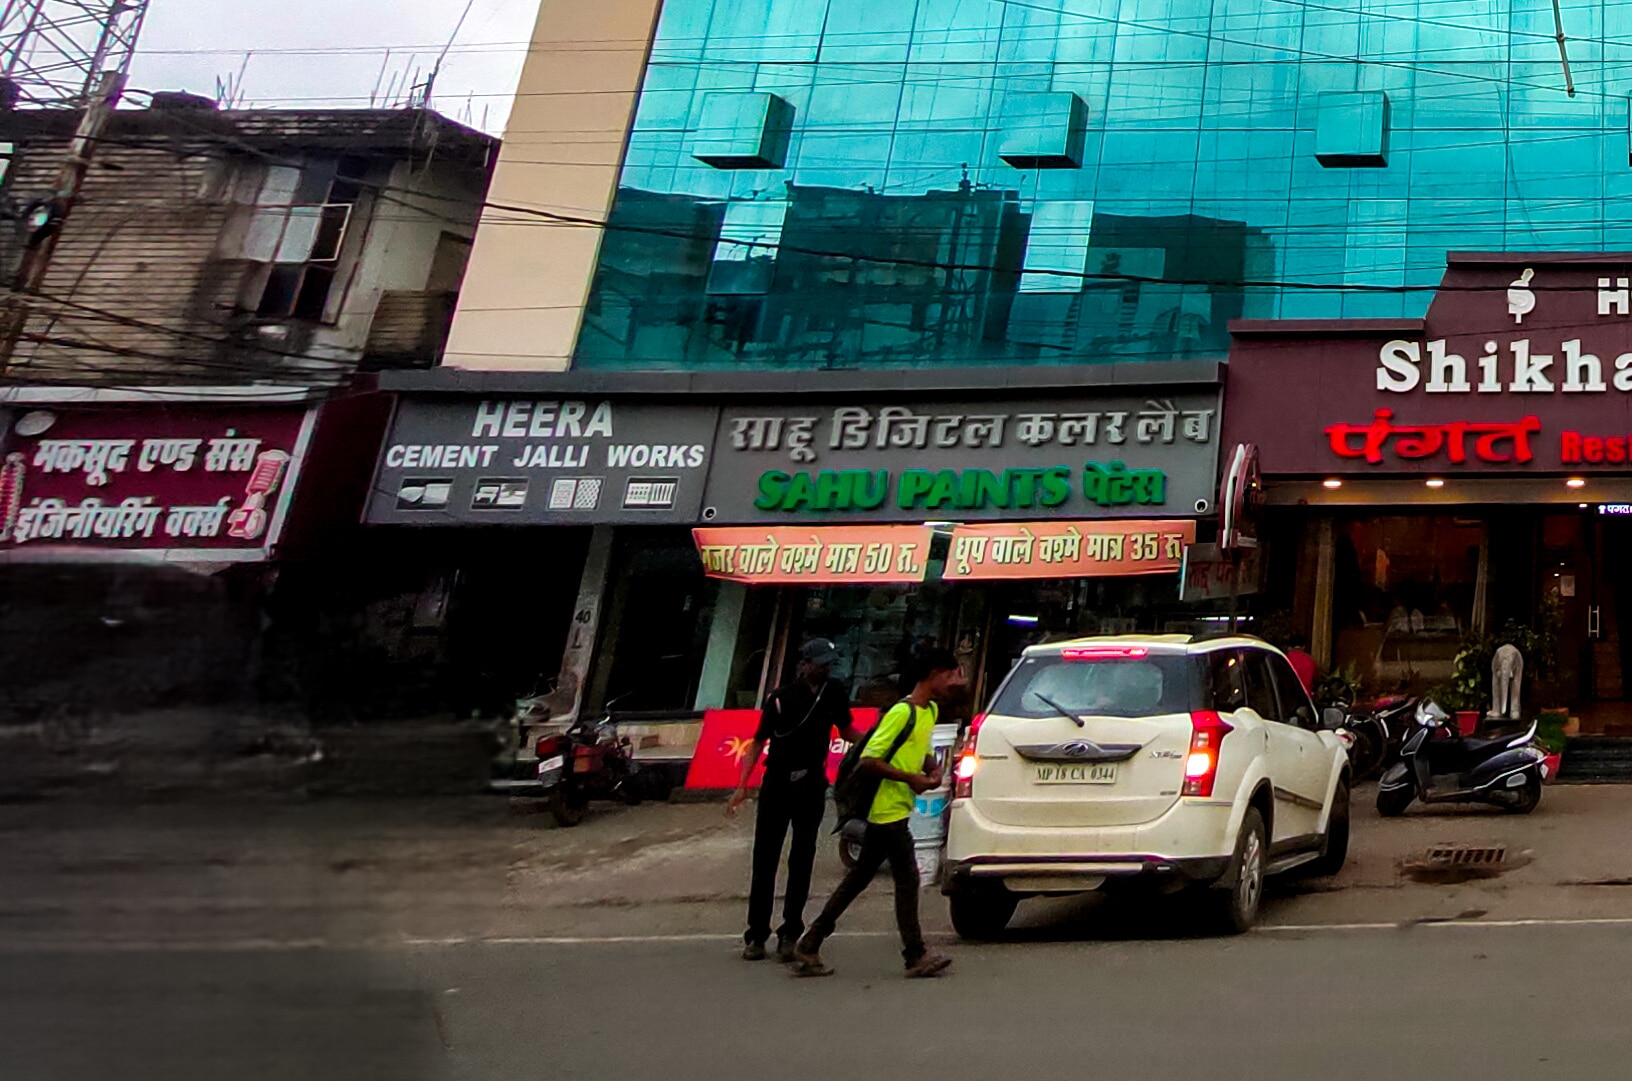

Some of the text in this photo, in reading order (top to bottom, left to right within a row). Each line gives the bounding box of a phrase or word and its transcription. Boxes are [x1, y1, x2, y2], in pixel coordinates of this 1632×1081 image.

[471, 400, 614, 438] HEERA
[730, 416, 822, 462] साहू
[828, 406, 1009, 448] डिजिटल
[1016, 411, 1130, 446] कलर
[33, 428, 261, 486] मकसूद एण्ड संस
[386, 445, 705, 469] CEMENT JALLI WORKS
[753, 465, 1072, 511] SAHU PAINTS
[740, 534, 780, 574] वाले
[825, 544, 863, 574] मात्र
[864, 543, 893, 573] 50
[955, 536, 989, 575] धूप
[991, 527, 1036, 564] वाले
[1087, 533, 1126, 562] मात्र
[1130, 533, 1160, 561] 35
[575, 609, 591, 624] 40
[1037, 767, 1053, 780] MP
